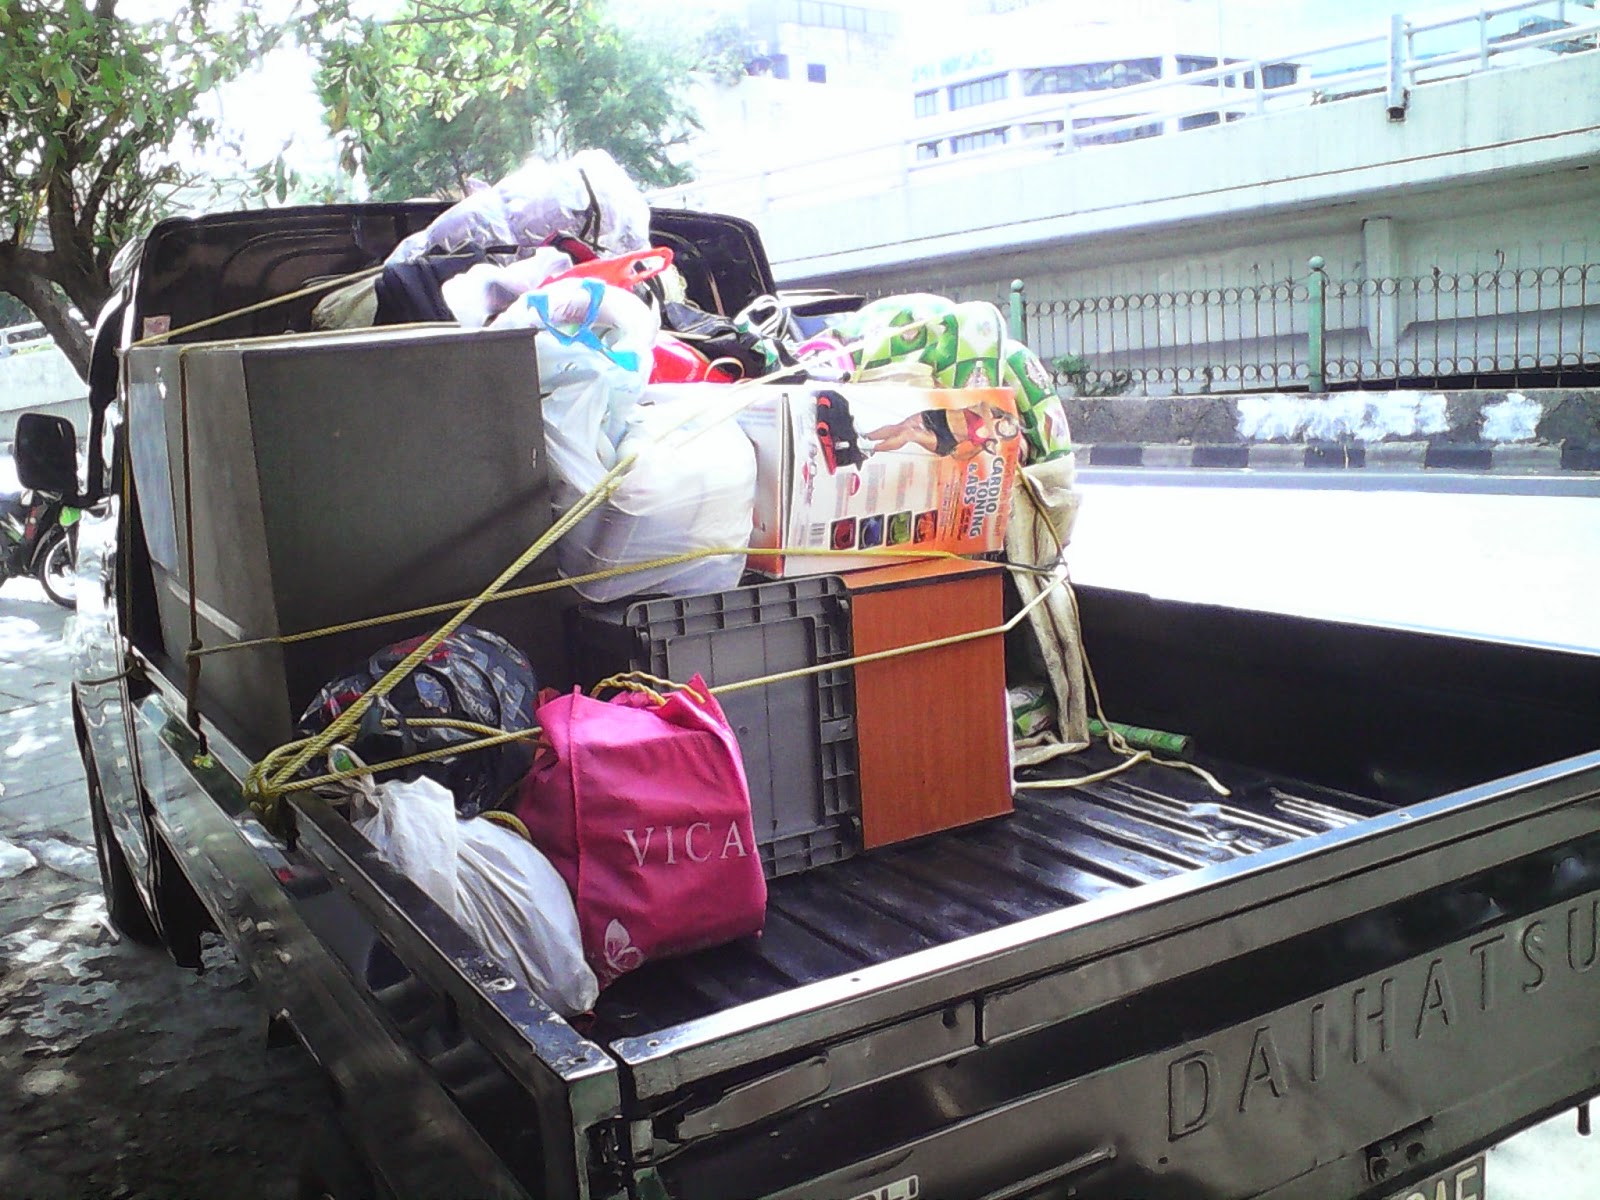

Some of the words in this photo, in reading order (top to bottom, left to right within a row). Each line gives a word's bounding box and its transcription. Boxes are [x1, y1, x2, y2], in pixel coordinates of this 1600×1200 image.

[964, 476, 978, 505] ABS
[969, 480, 989, 537] TONING
[985, 456, 1004, 513] CARDIO
[623, 820, 748, 867] VICA
[1167, 898, 1600, 1142] DAIHATSU
